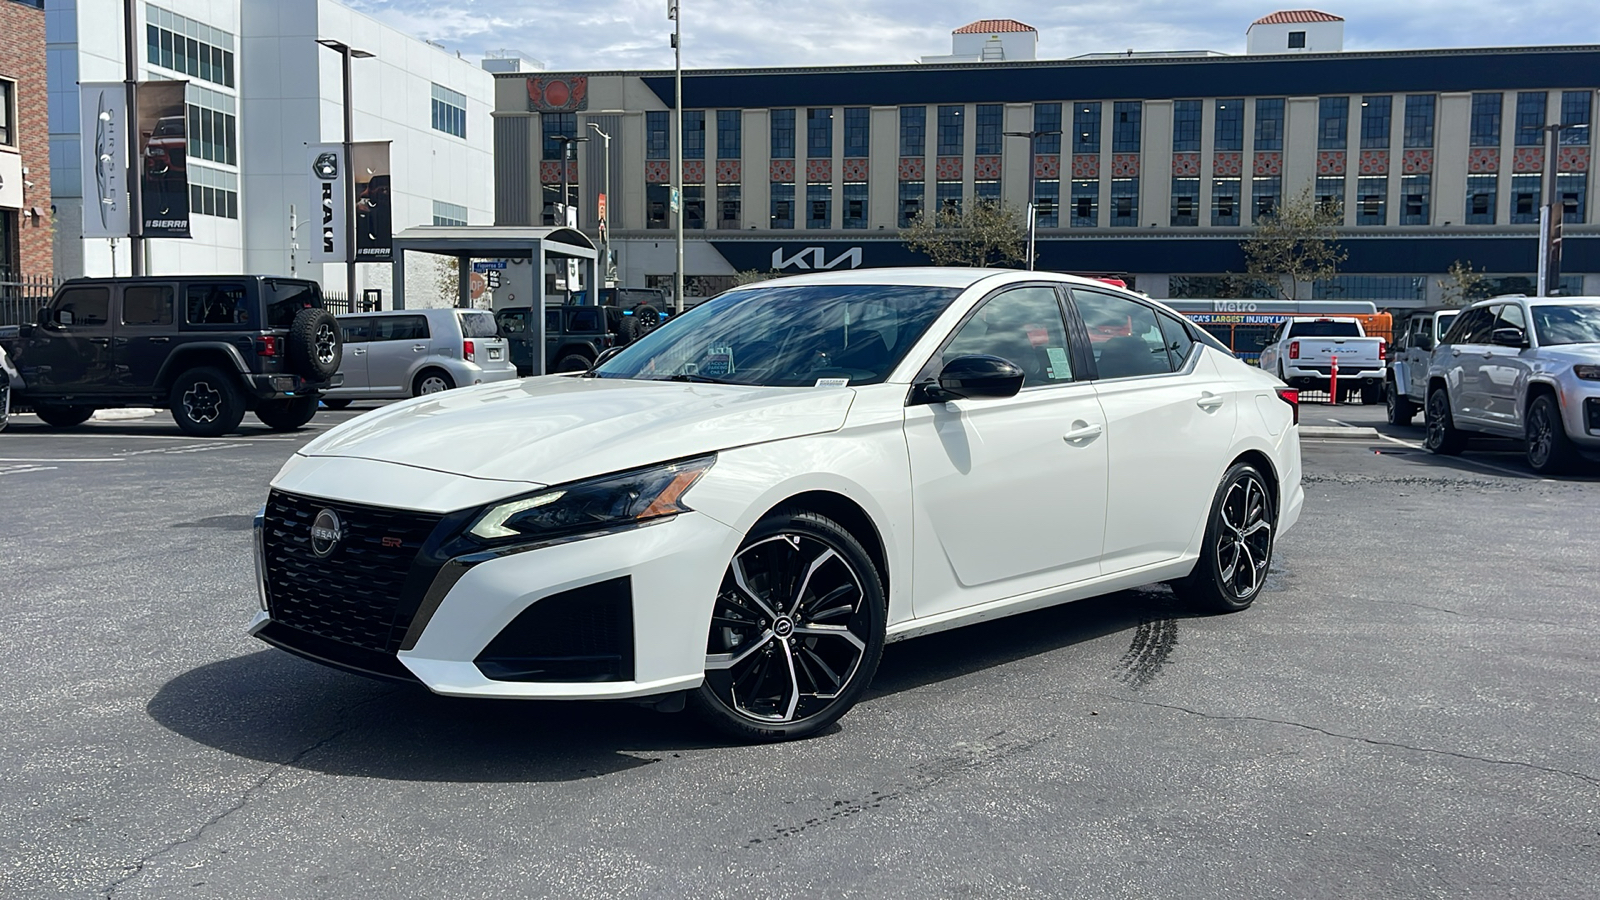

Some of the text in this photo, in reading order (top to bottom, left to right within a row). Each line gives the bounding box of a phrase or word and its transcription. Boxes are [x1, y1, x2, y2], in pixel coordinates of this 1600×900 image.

[109, 108, 117, 212] CHRYSLER
[151, 219, 188, 228] SIERRA
[322, 183, 334, 253] RAM
[772, 246, 863, 269] KIA
[471, 280, 483, 291] OP
[1214, 301, 1257, 313] Metro
[1185, 315, 1211, 323] RICA'S
[1211, 315, 1245, 324] LARGEST
[1246, 316, 1275, 324] INJURY
[382, 536, 403, 547] SR
